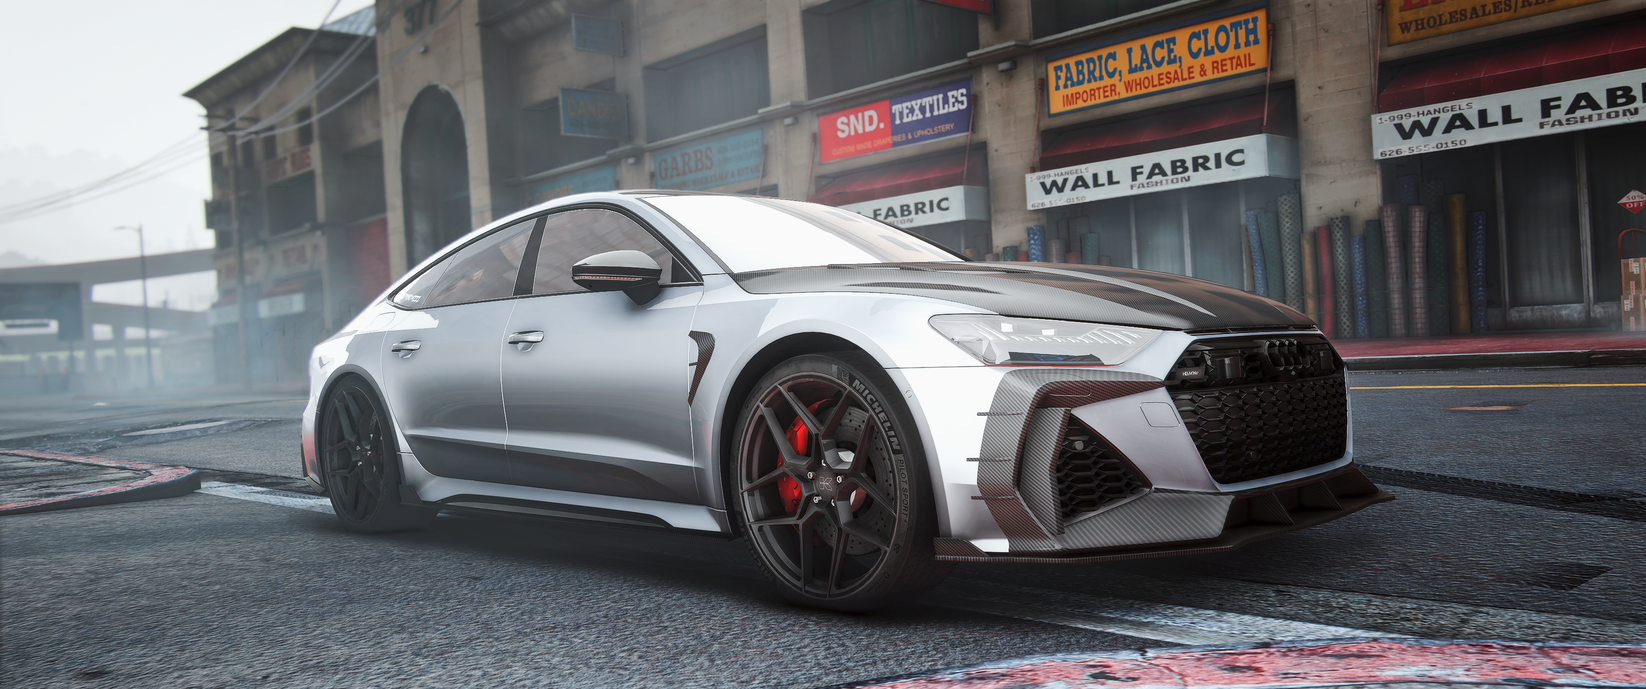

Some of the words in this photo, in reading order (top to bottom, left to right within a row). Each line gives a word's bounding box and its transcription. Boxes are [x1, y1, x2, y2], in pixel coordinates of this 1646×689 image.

[1053, 51, 1123, 91] FABRIC,
[1126, 36, 1182, 74] LACE,
[1187, 16, 1260, 59] CLOTH
[1062, 84, 1121, 107] IMPORTER,
[1124, 66, 1195, 94] WHOLESALE
[1199, 63, 1208, 77] &
[1211, 53, 1256, 75] RETAIL
[836, 109, 885, 138] SND.
[892, 88, 968, 124] TEXTILES
[1378, 102, 1474, 124] 1-999-HANGELS
[1393, 105, 1523, 141] WALL
[1540, 82, 1646, 119] FAB
[1538, 107, 1640, 130] FASHION
[832, 144, 855, 156] CUSTOM
[856, 140, 873, 151] MADE
[873, 133, 906, 148] DRAPERIES
[914, 123, 955, 138] UPHOLSTERY
[1380, 138, 1467, 158] 626-555-0150
[659, 145, 714, 181] GARBS
[1040, 170, 1120, 195] WALL
[1131, 149, 1246, 182] FABRIC
[1130, 175, 1191, 190] FASHION
[873, 197, 950, 221] FABRIC
[852, 379, 901, 450] MICHELIN
[898, 459, 908, 485] PILOT
